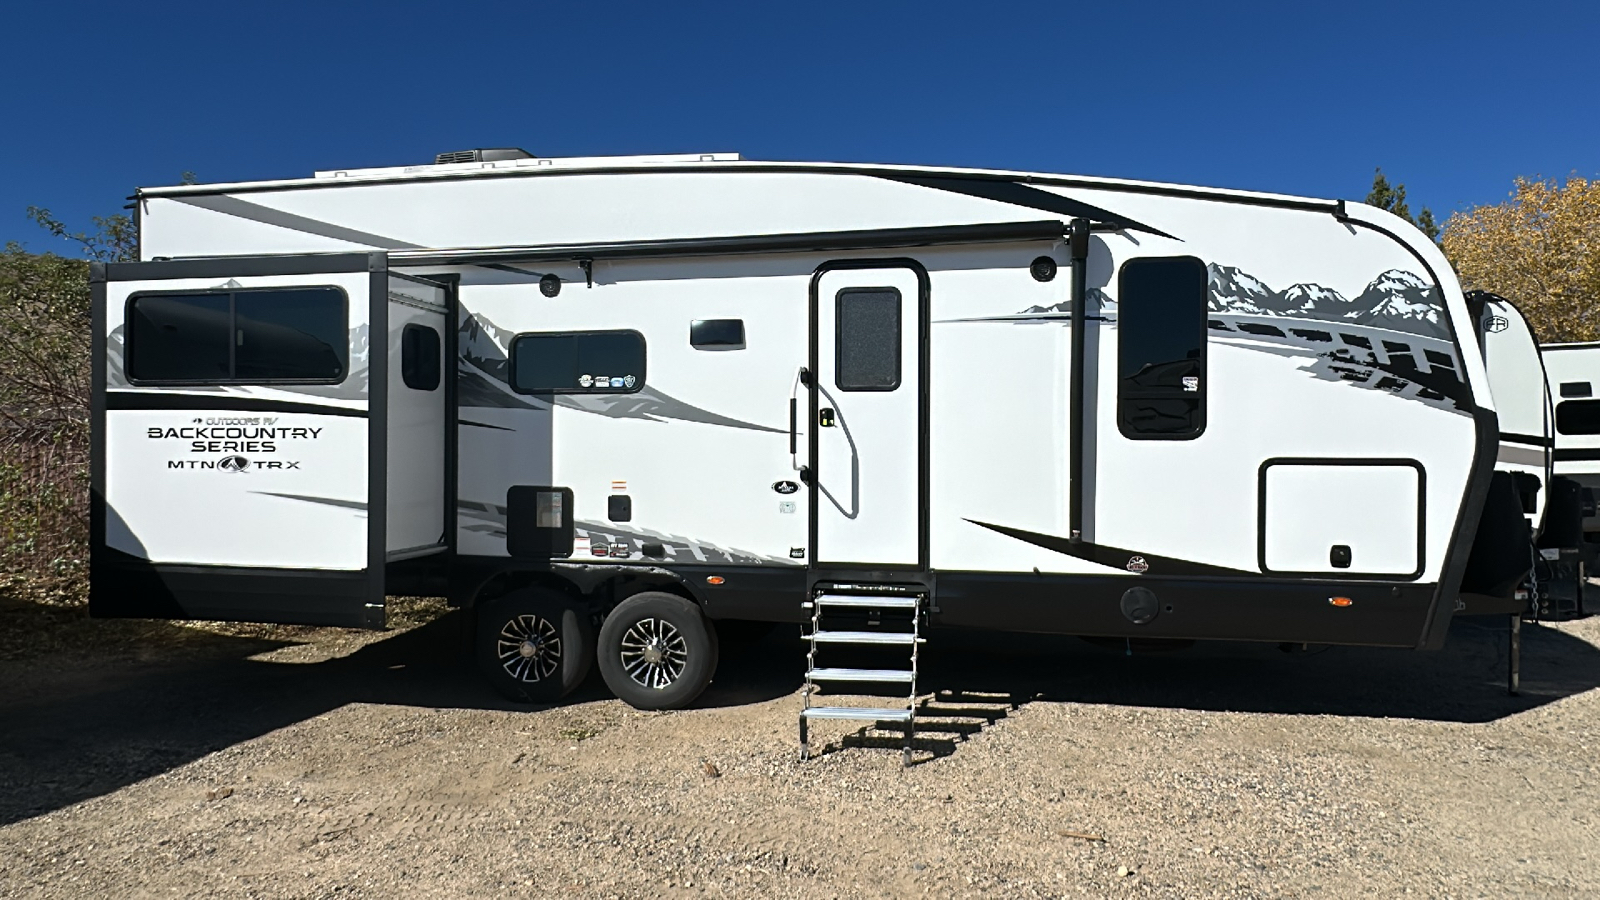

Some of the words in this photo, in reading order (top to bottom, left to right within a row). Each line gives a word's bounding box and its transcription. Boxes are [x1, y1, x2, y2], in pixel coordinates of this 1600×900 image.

[205, 417, 260, 426] OUTDOORS
[147, 427, 323, 439] BACKCOUNTRY
[190, 441, 277, 453] SERIES
[167, 460, 215, 470] MTN
[252, 460, 300, 470] TRX
